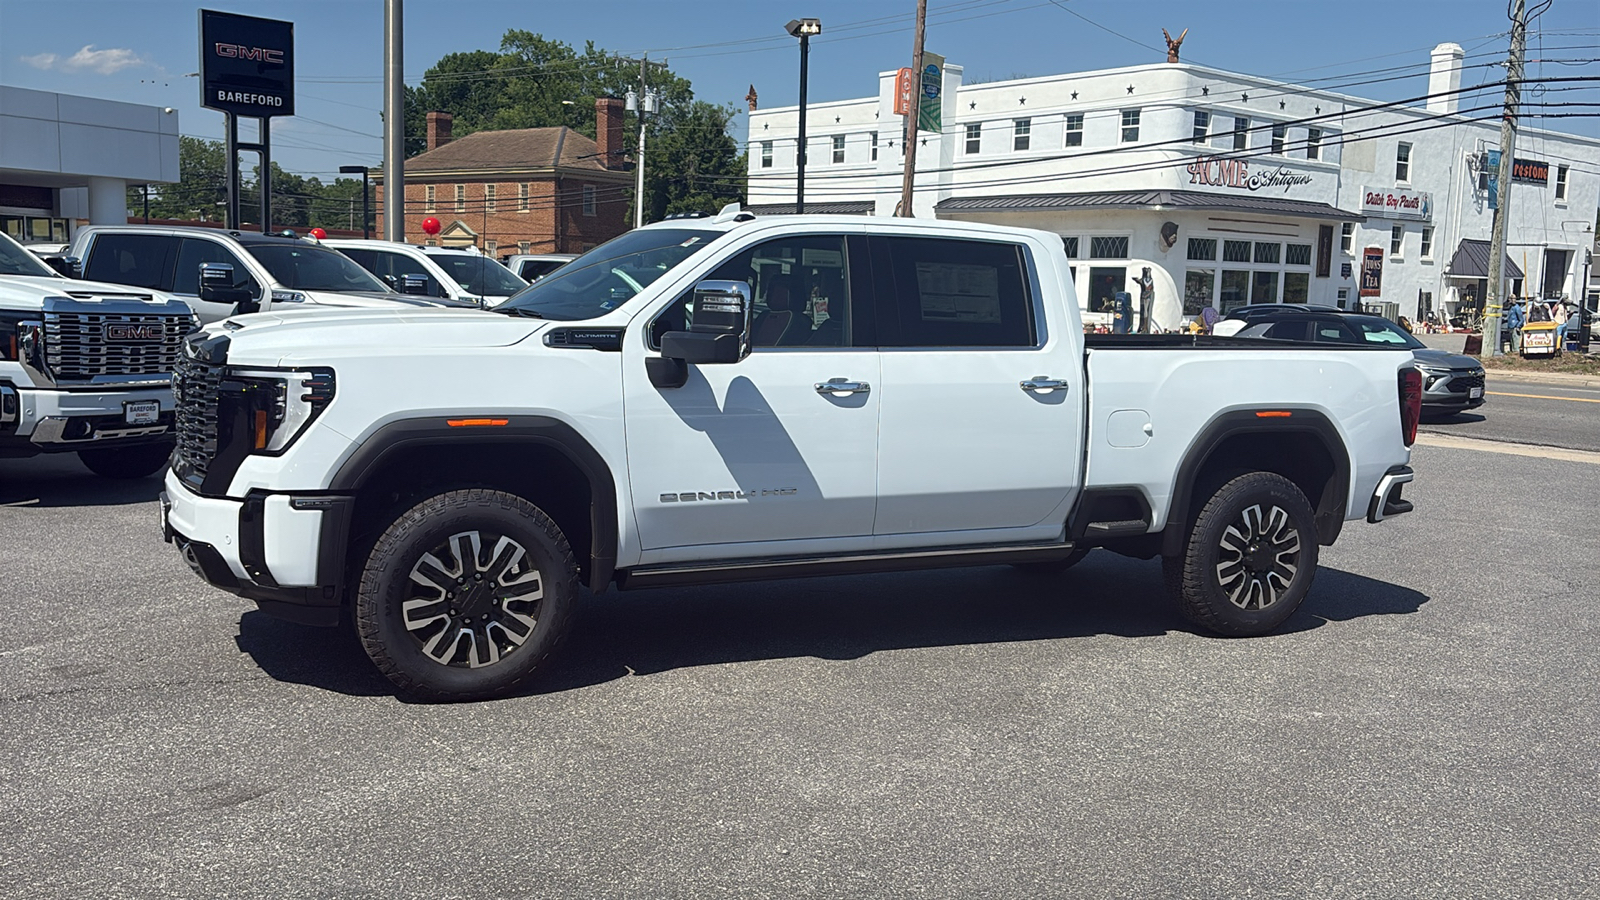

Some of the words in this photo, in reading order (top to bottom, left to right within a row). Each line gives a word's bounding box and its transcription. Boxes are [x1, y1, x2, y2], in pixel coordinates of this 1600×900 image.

[215, 42, 284, 64] GMC
[218, 91, 282, 107] BAREFORD
[902, 71, 911, 112] ACME
[1186, 154, 1249, 189] ACME
[1247, 164, 1313, 193] Antiques
[1513, 163, 1548, 180] restone
[1365, 191, 1385, 206] Dutch
[1386, 193, 1400, 210] Boy
[1400, 194, 1420, 209] Paints
[1366, 275, 1378, 287] TEA
[108, 325, 166, 339] GMC
[660, 491, 756, 503] DENALI
[761, 488, 798, 497] HD
